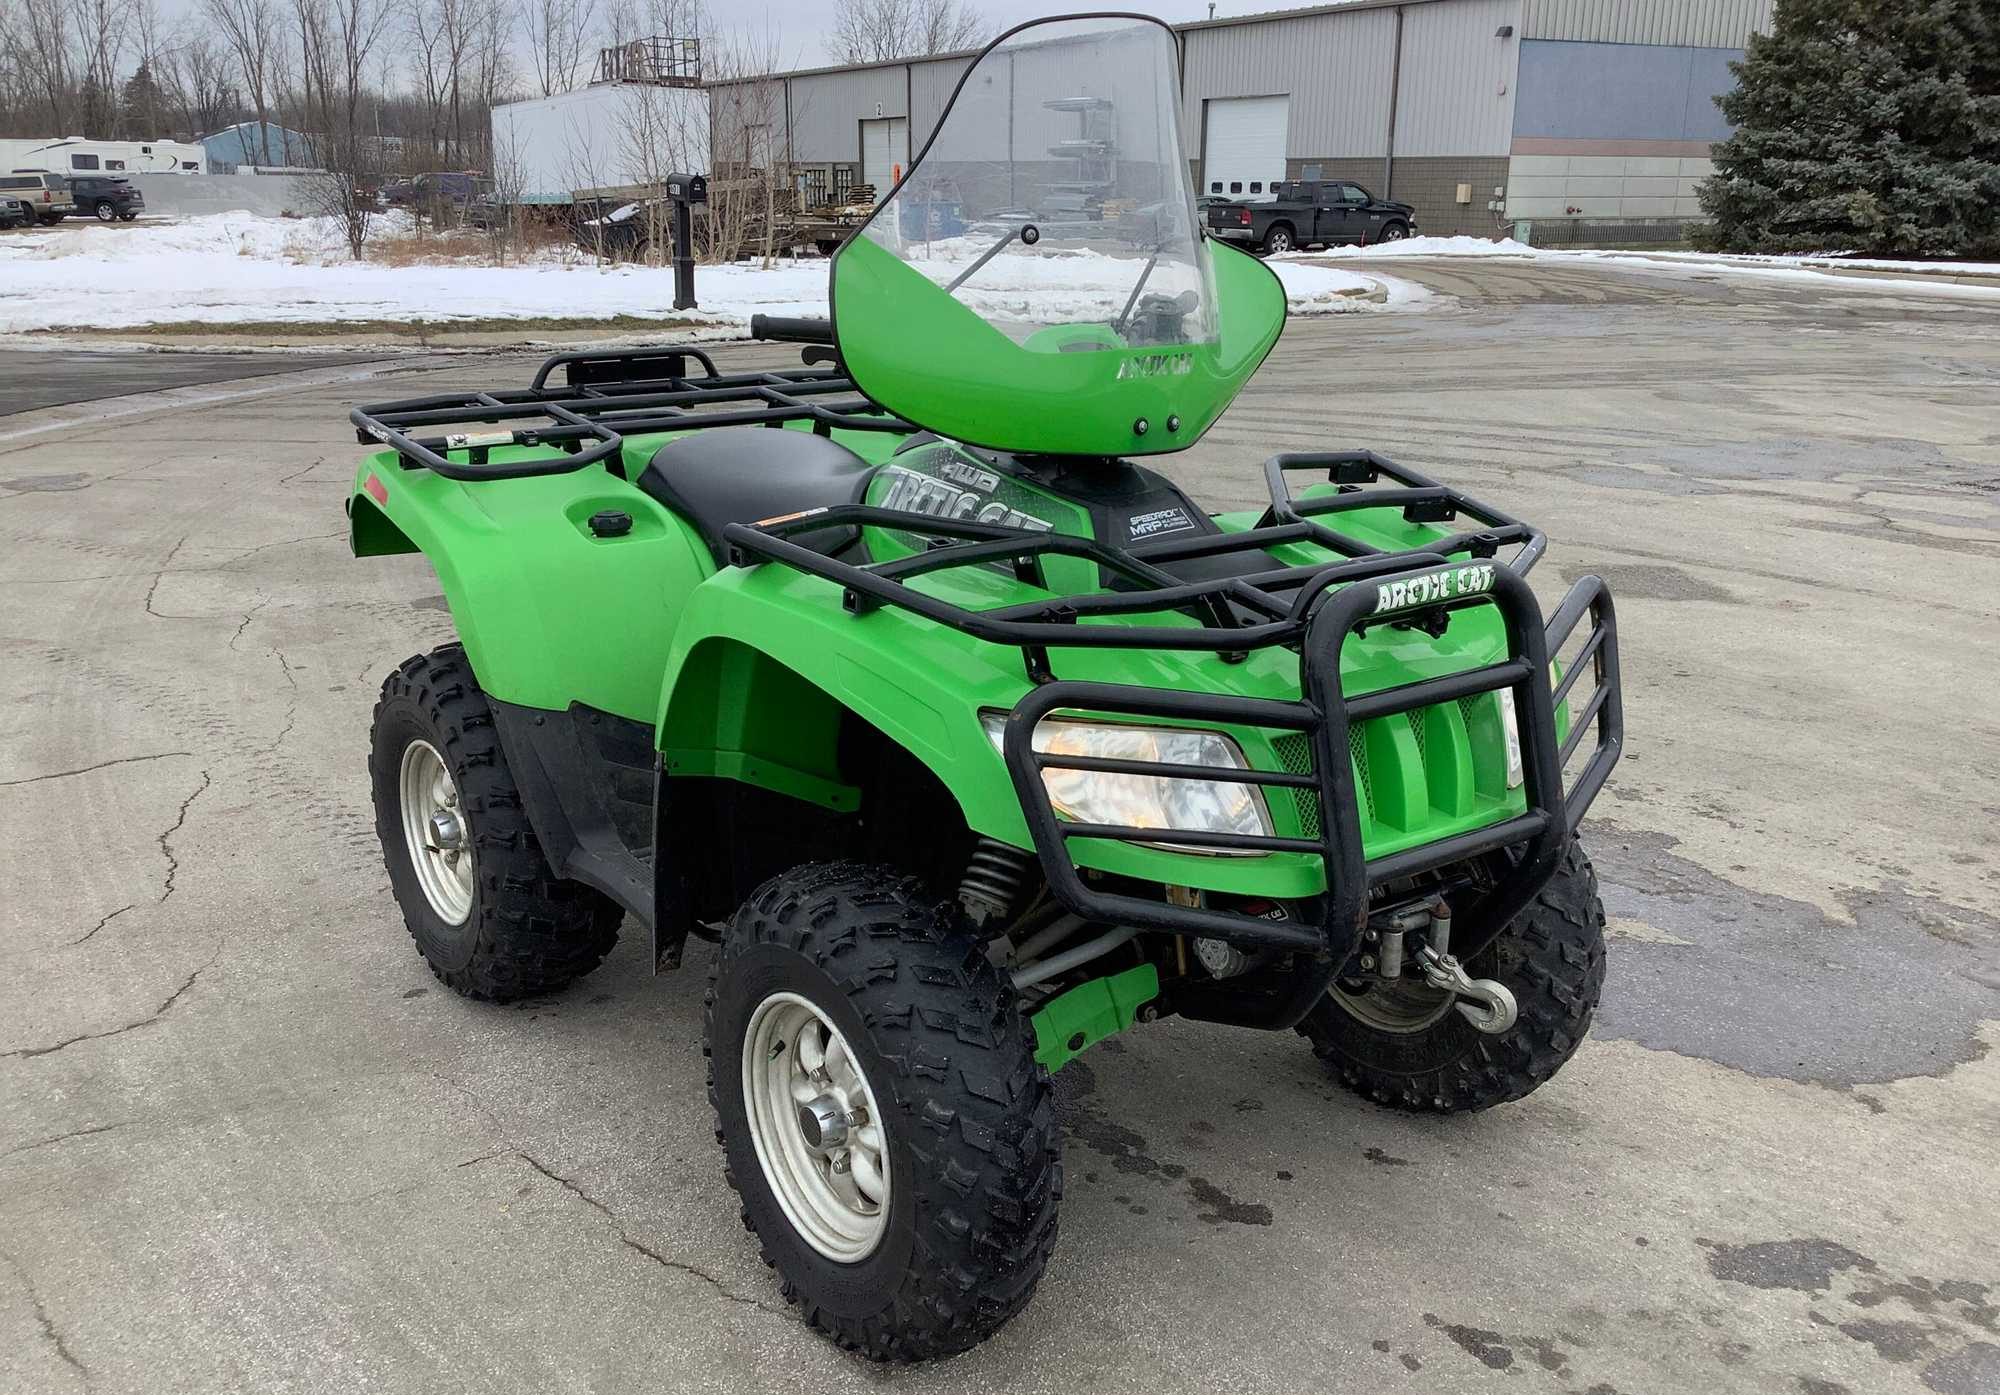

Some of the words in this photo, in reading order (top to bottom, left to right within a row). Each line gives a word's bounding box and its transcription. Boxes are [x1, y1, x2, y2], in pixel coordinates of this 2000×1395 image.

[942, 462, 1001, 494] 4WD
[1130, 520, 1162, 536] MRP
[1374, 573, 1451, 613] ARCTIC
[1457, 565, 1493, 593] CAT
